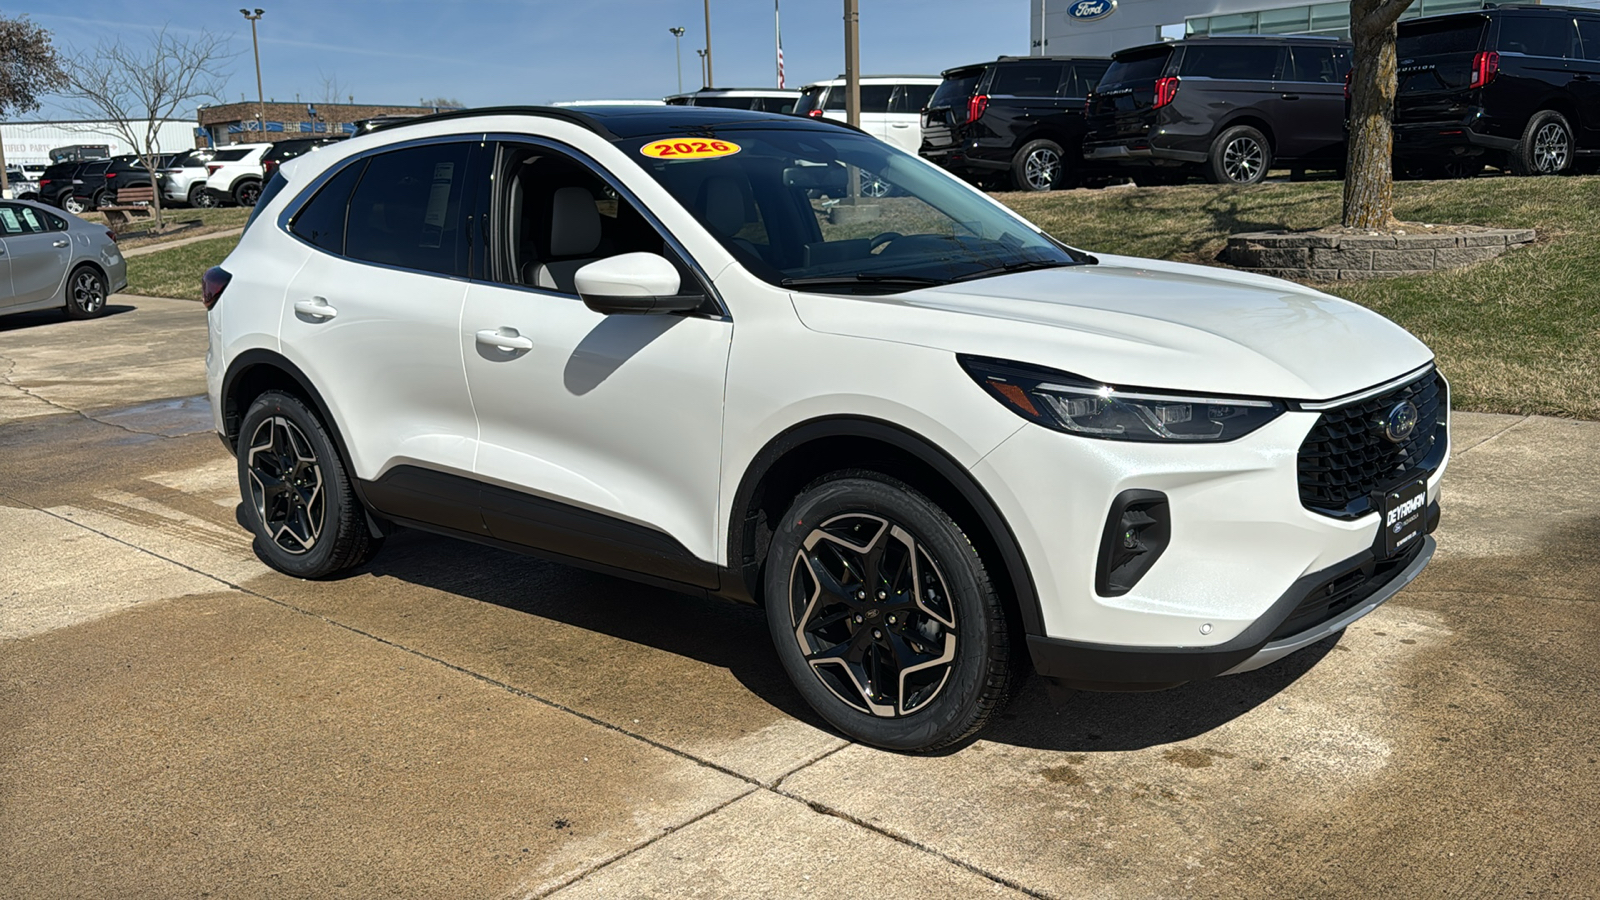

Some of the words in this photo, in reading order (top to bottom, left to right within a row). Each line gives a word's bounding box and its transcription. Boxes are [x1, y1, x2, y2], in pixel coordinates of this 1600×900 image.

[1075, 1, 1104, 17] Ford
[4, 143, 26, 153] TIFIED
[654, 141, 731, 156] 2026
[1386, 491, 1426, 528] DEYARMAN
